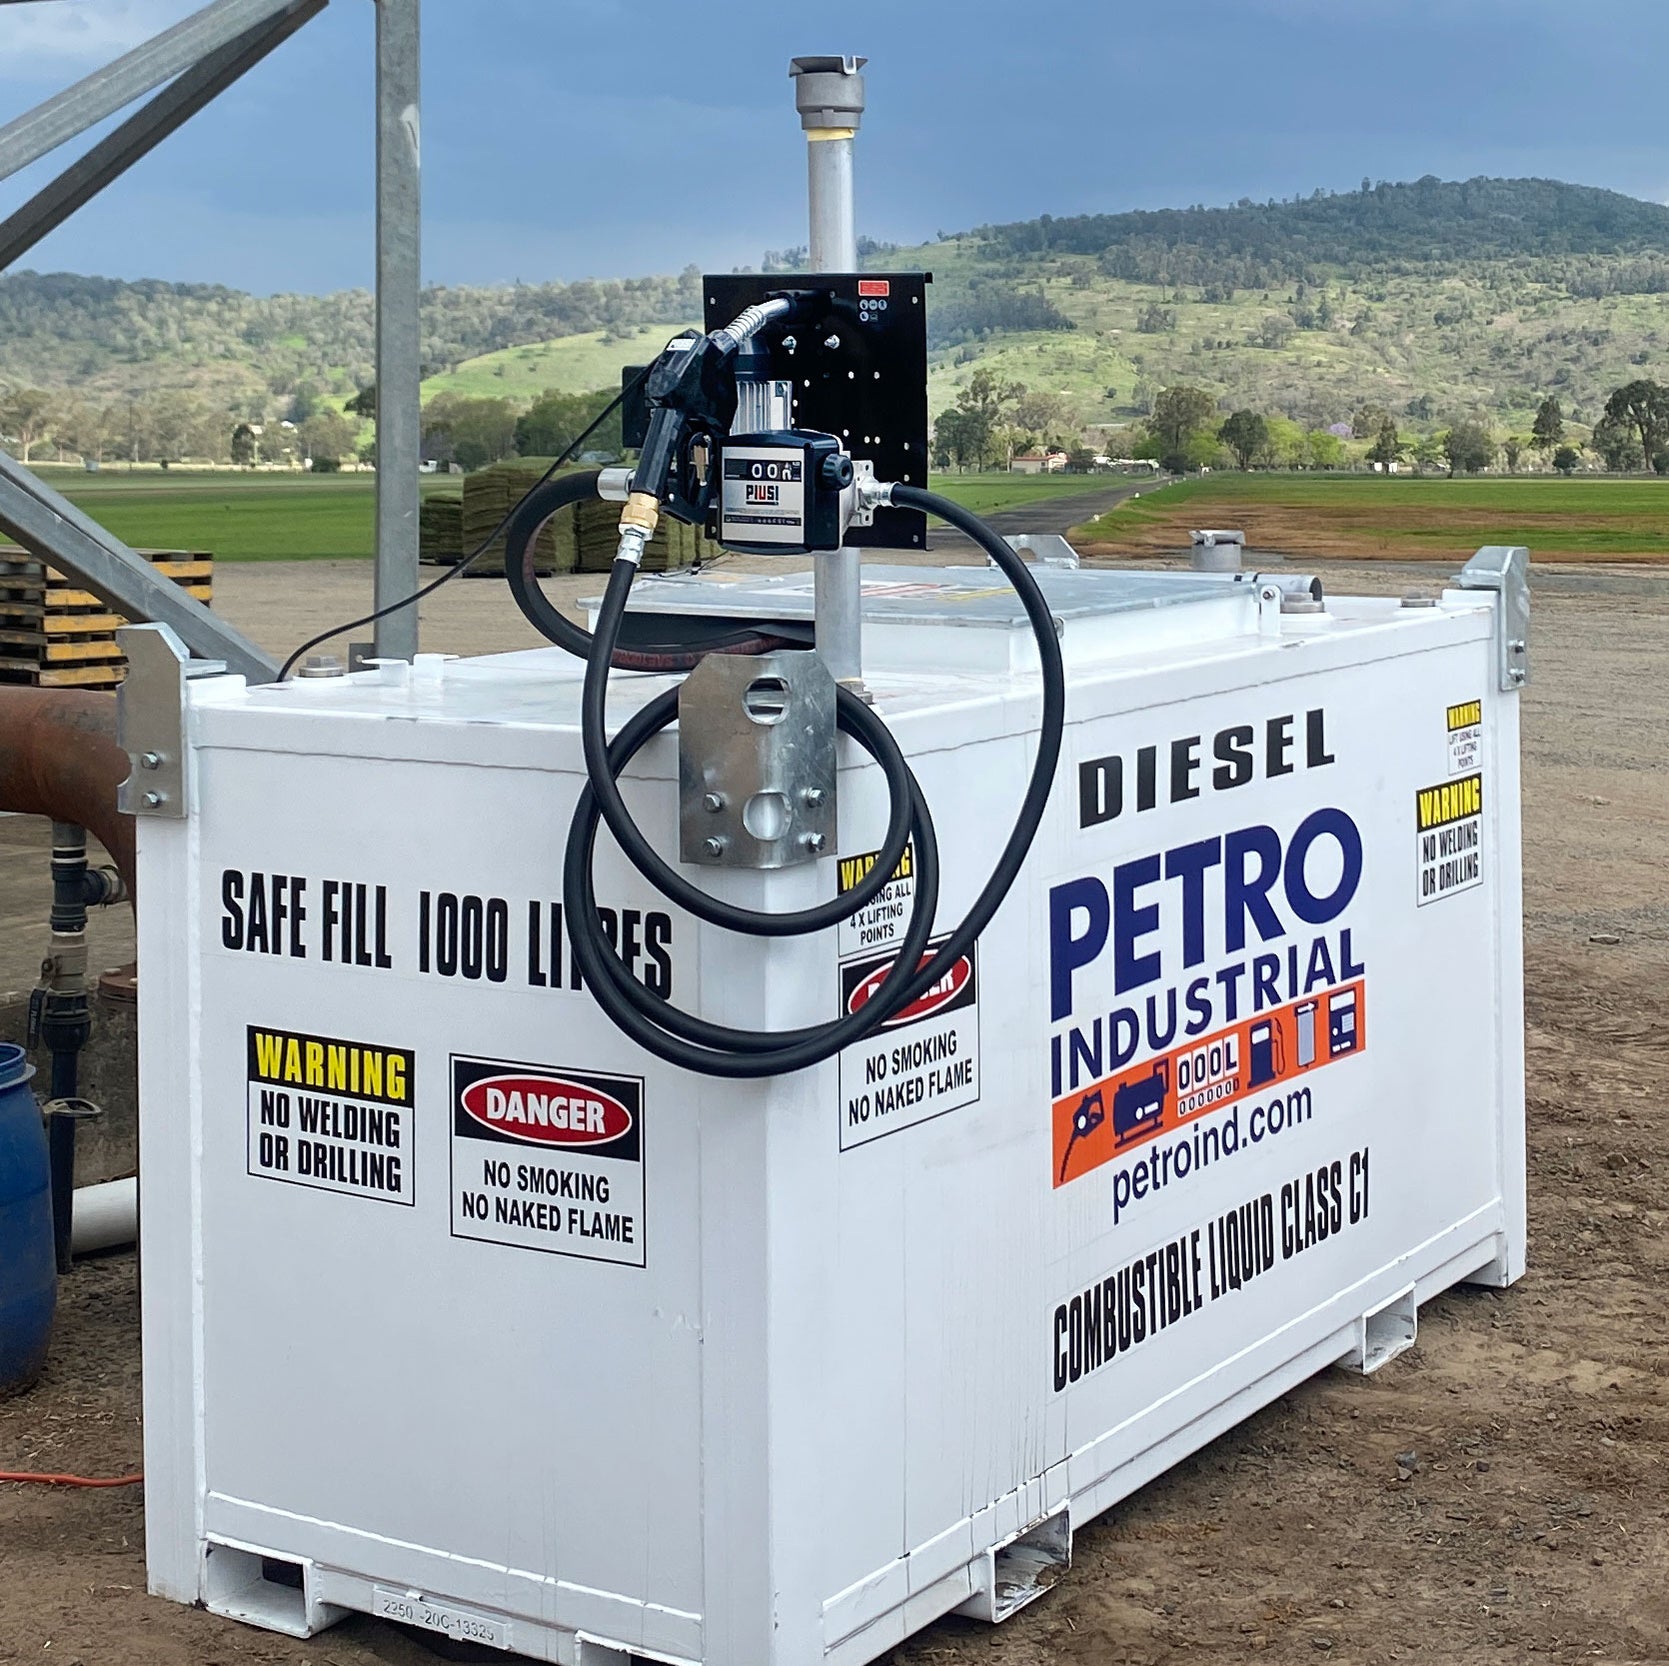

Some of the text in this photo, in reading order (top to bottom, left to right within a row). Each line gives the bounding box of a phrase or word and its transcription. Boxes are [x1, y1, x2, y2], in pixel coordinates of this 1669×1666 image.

[746, 484, 779, 501] PIUSI
[1078, 708, 1335, 829] DIESEL
[1419, 777, 1480, 827] WARNING
[1423, 820, 1478, 864] NO WELDING
[895, 882, 911, 899] ALL
[1423, 852, 1479, 897] OR DRILLING
[222, 869, 672, 1000] SAFE FILL 1000 LIES
[858, 912, 866, 927] X
[867, 902, 903, 925] LIFTING
[860, 923, 895, 945] POINTS
[1049, 807, 1363, 1023] PETRO
[1051, 928, 1365, 1098] INDUSTRIAL
[255, 1032, 406, 1101] WARNING
[866, 1030, 957, 1085] NO SMOKING
[260, 1090, 401, 1149] NO WELDING
[486, 1087, 606, 1135] DANGER
[849, 1058, 973, 1127] NO NAKED FLAME
[259, 1132, 401, 1193] OR DRILLING
[483, 1159, 610, 1204] NO SMOKING
[1112, 1086, 1313, 1225] petroind.com
[462, 1191, 634, 1244] NO NAKED FLAME
[1053, 1147, 1370, 1393] COMBUSTIBLE LIQUID CLASS C1
